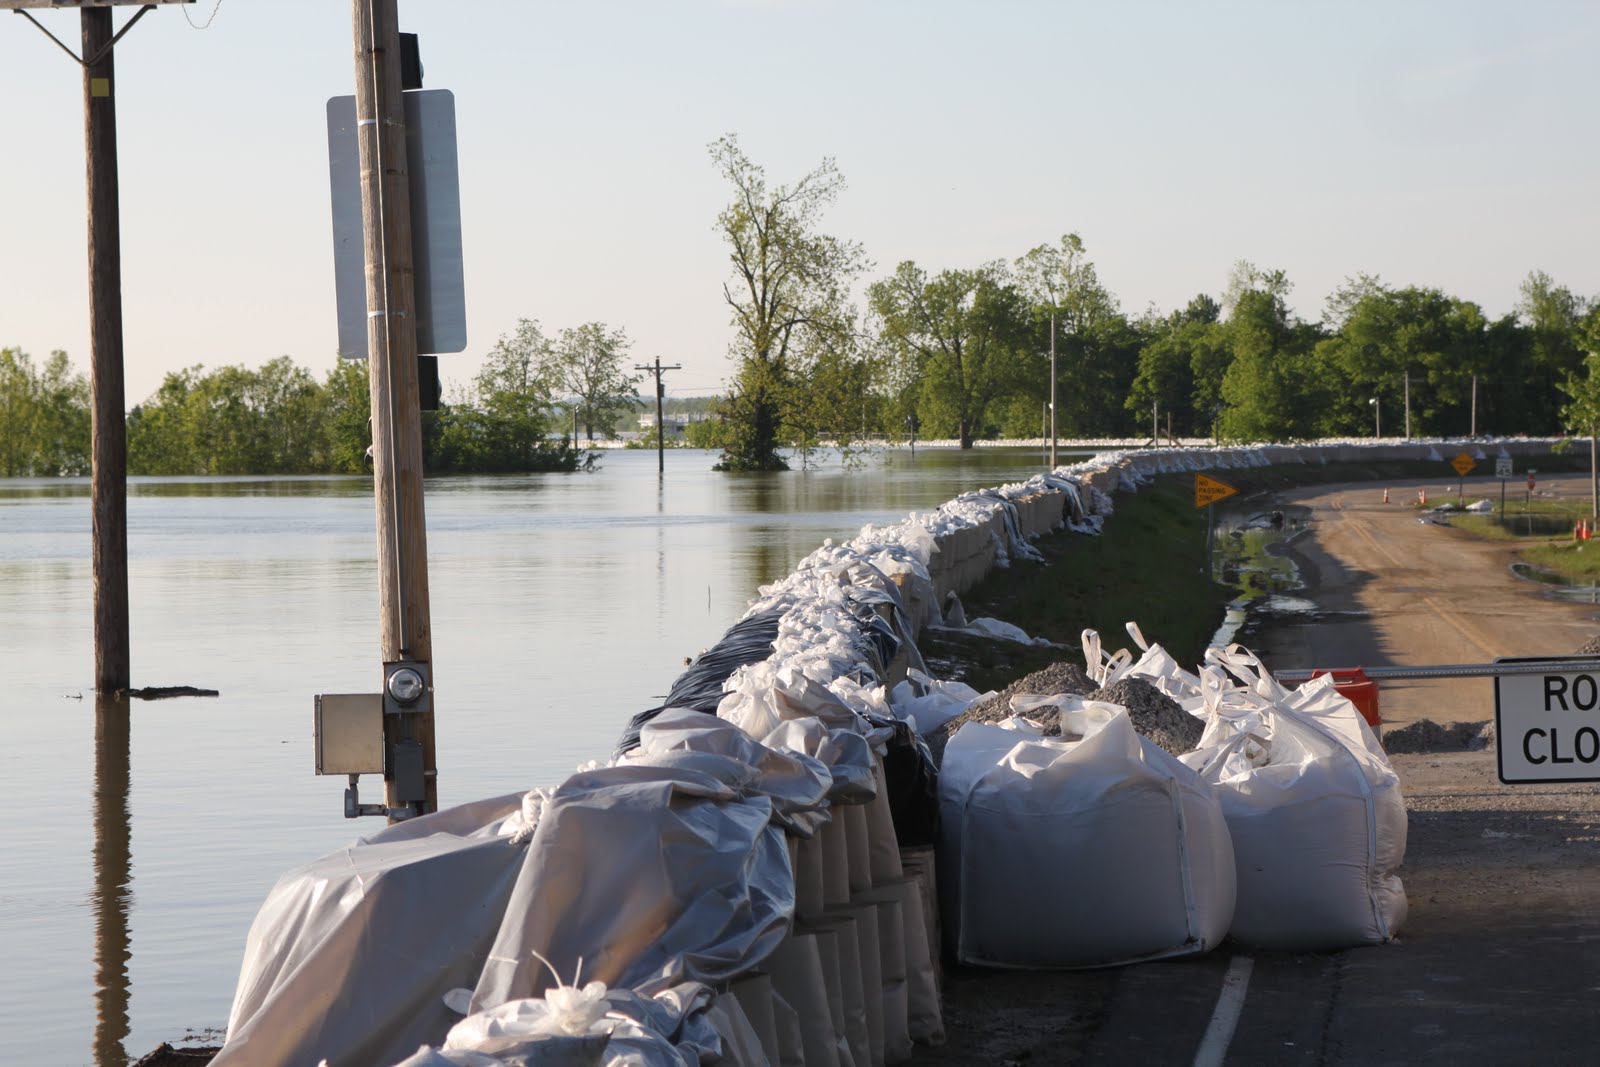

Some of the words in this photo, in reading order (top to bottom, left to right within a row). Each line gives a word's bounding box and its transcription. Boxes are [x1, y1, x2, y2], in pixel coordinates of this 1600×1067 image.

[1497, 469, 1511, 477] 45
[1198, 487, 1226, 495] PASSING
[1543, 674, 1600, 711] RO
[1523, 726, 1600, 765] CLO
